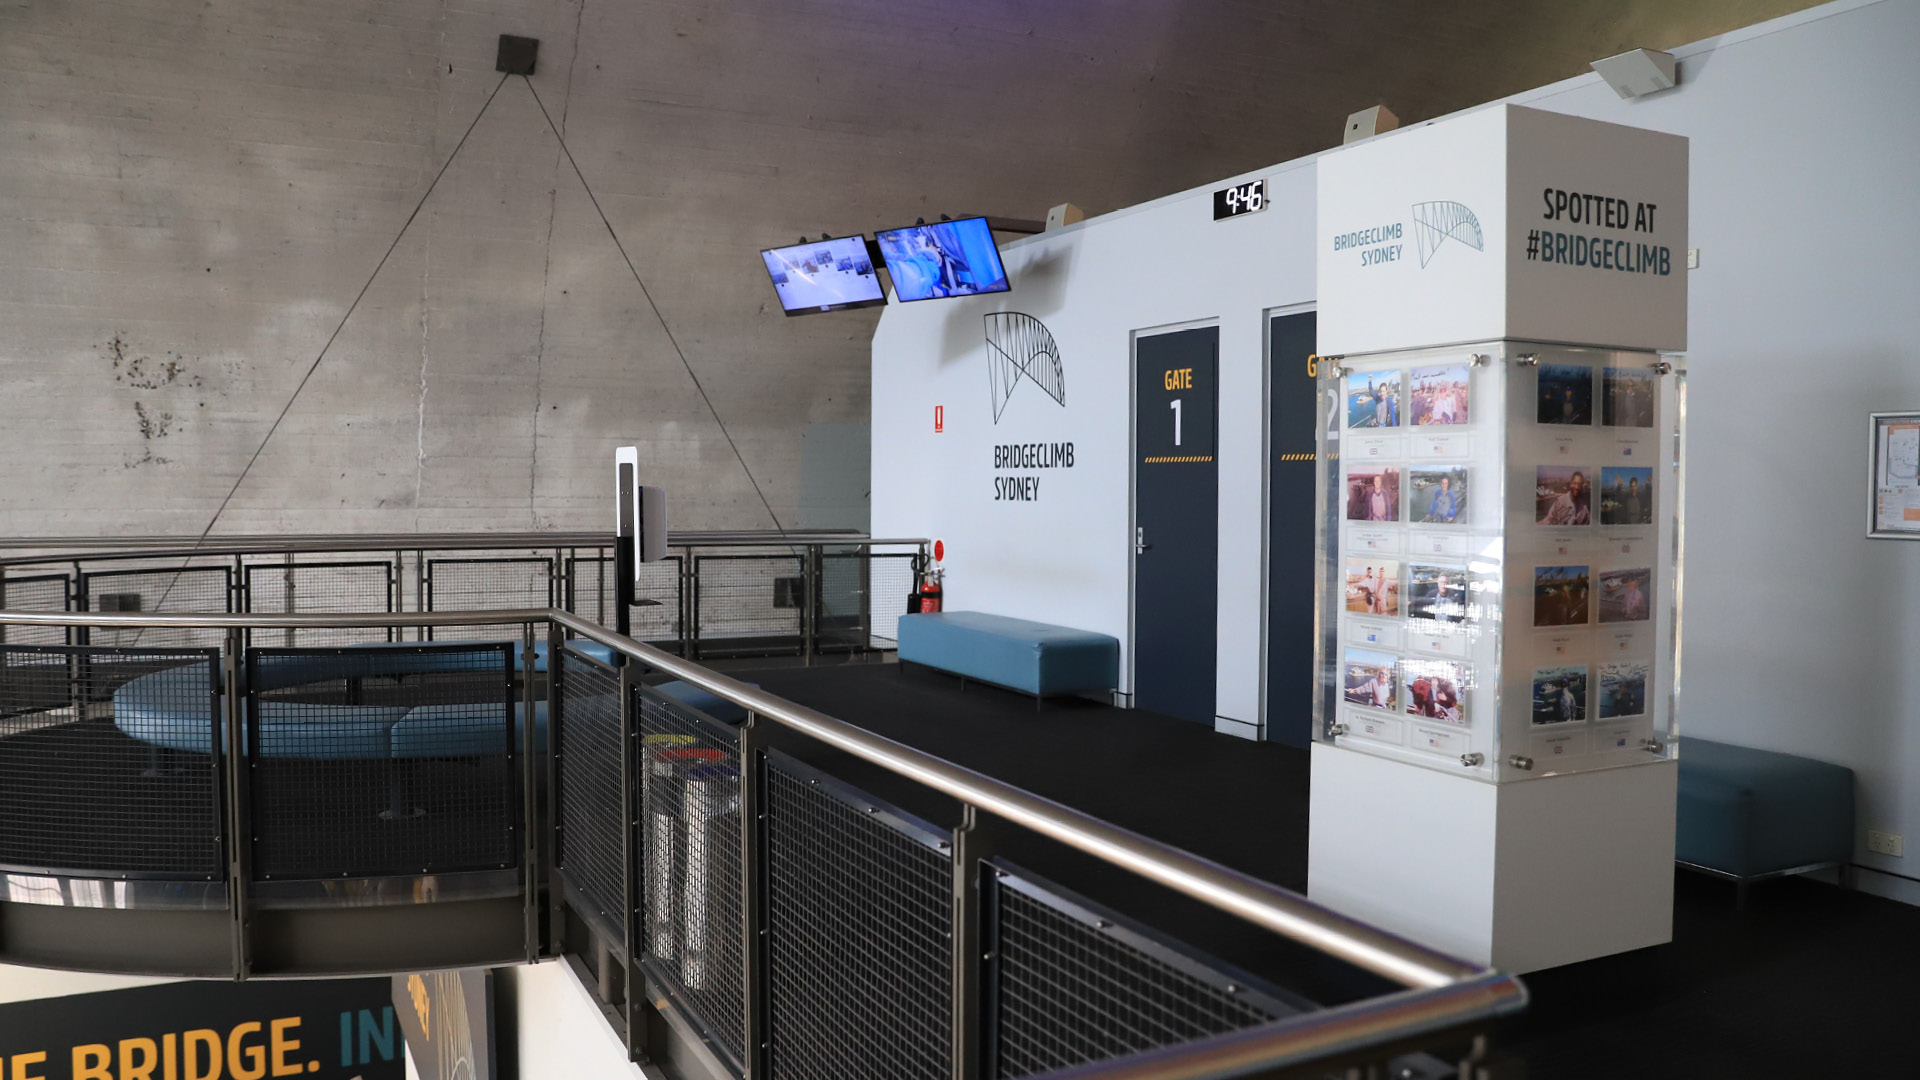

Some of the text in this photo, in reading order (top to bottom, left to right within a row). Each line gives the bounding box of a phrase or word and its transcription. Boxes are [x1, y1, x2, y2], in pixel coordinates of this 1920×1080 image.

[1226, 181, 1263, 214] 9:46
[1543, 188, 1657, 234] SPOTTED AT
[1334, 222, 1403, 252] BRIDGECLIMB
[1526, 229, 1671, 276] #BRIDGECLIMB
[1361, 244, 1403, 267] SYDNEY
[1164, 368, 1193, 391] GATE
[1170, 399, 1182, 446] 1
[994, 442, 1075, 469] BRIDGECLIMB
[994, 476, 1040, 502] SYDNEY
[72, 1016, 320, 1080] BRIDGE.
[340, 1005, 405, 1068] IN
